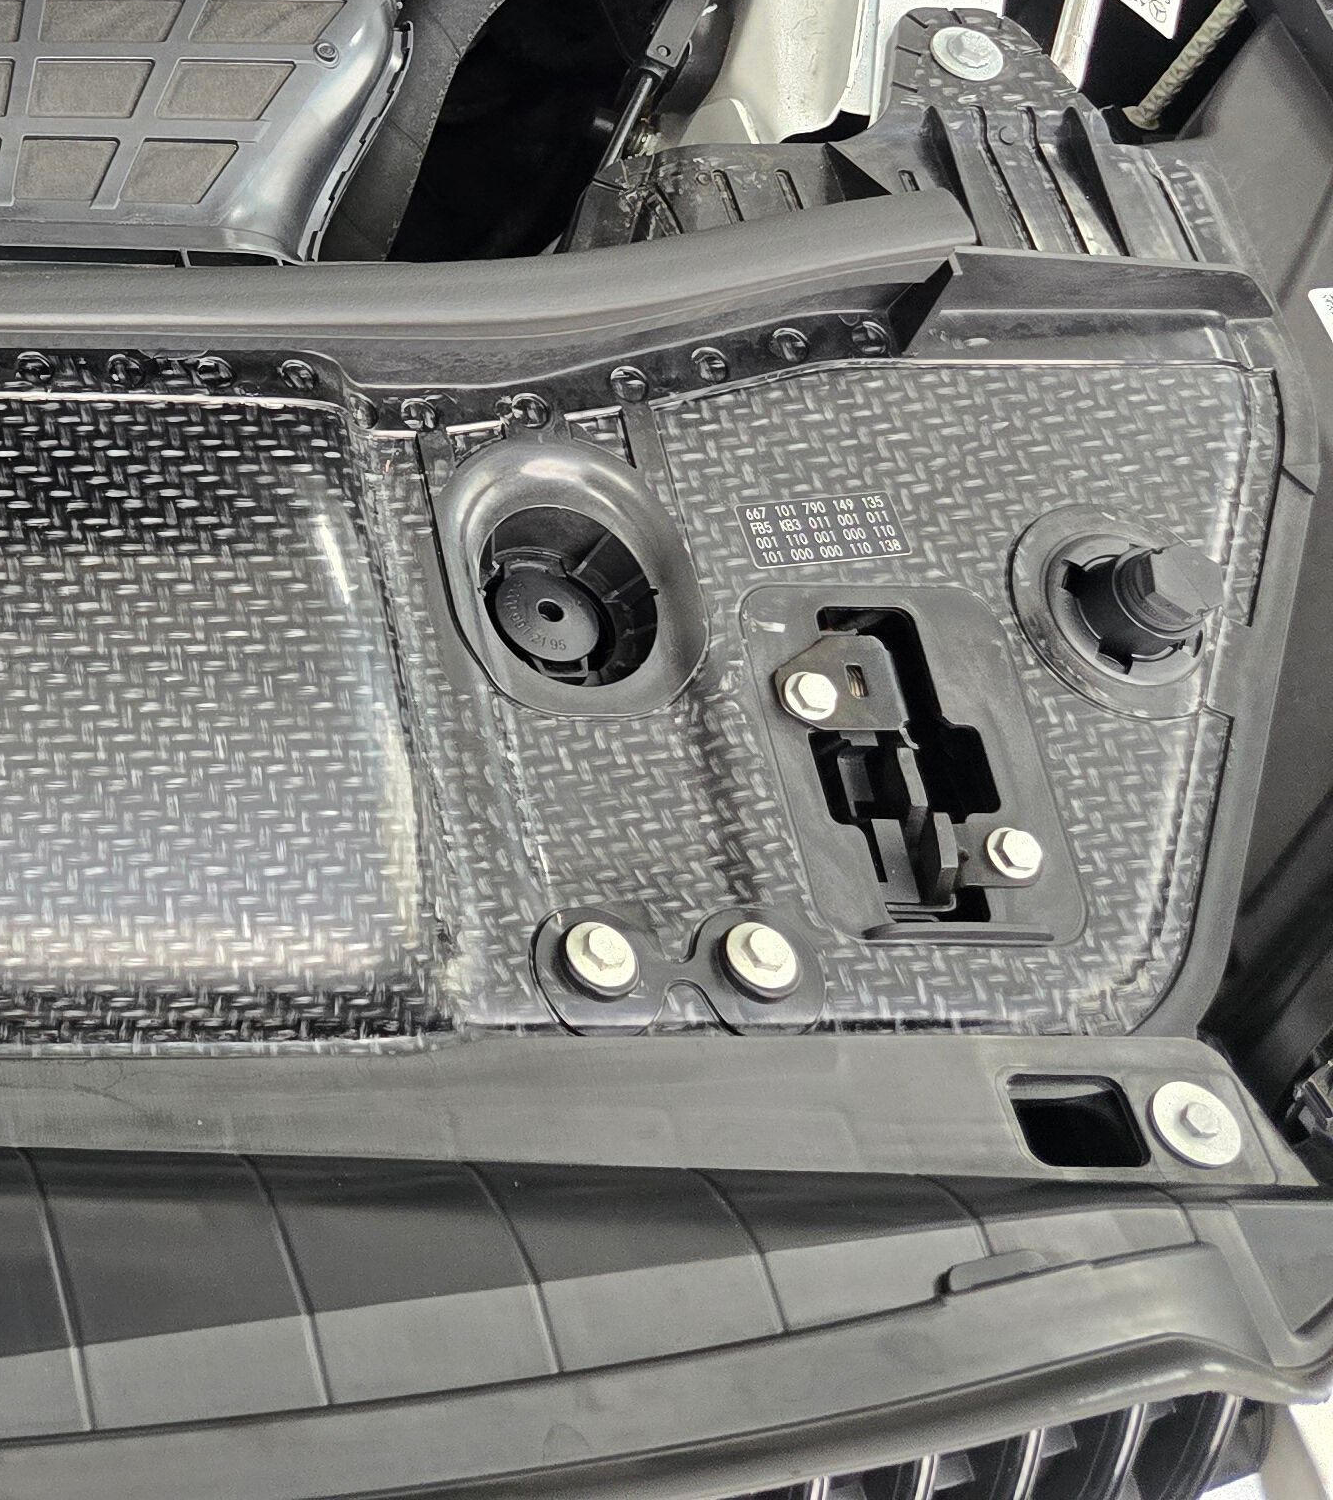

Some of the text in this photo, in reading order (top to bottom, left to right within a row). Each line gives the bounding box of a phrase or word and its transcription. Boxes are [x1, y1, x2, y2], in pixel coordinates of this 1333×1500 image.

[746, 496, 884, 521] 667 101 790 149 135
[750, 510, 889, 535] FB5 KB3 011 001 011
[756, 525, 895, 549] 001 110 001 000 110
[763, 539, 901, 564] 101 000 000 110 138
[549, 638, 567, 651] 95
